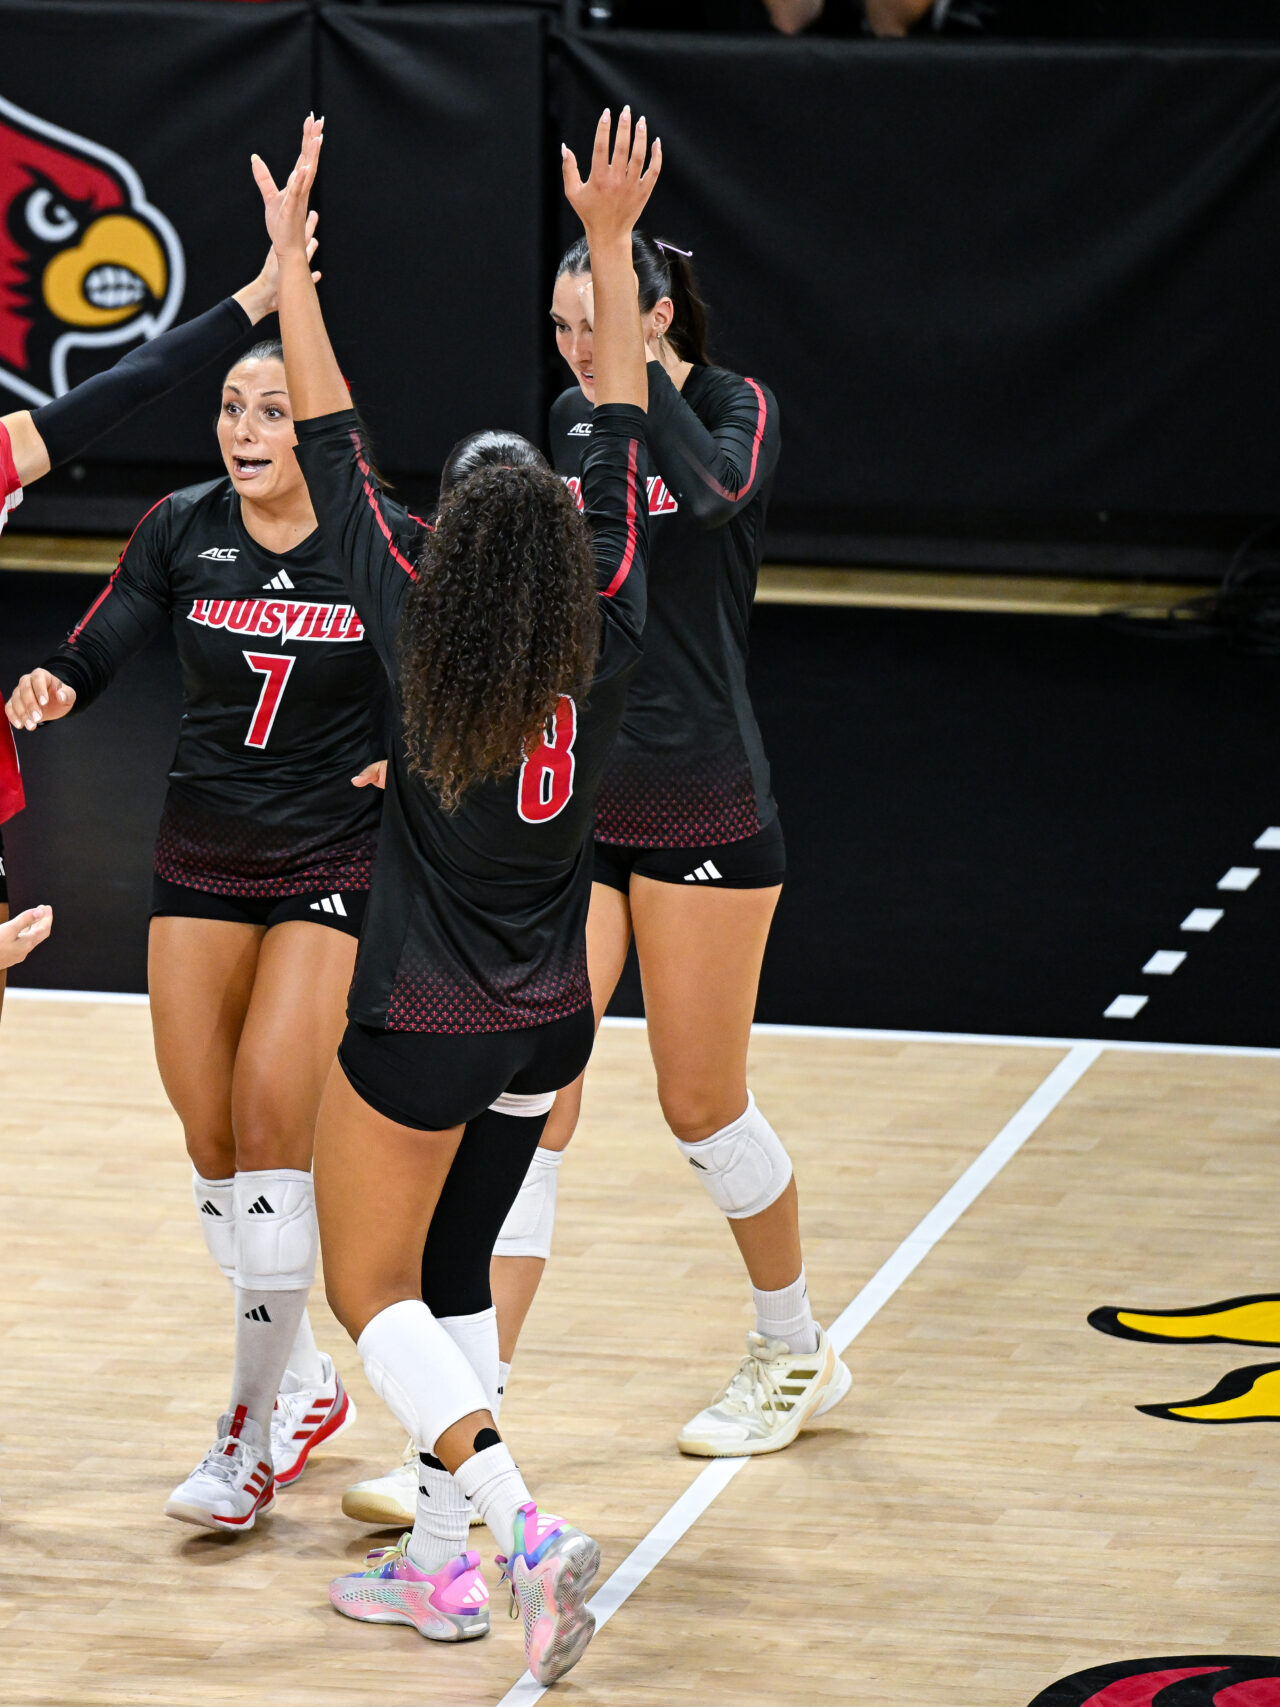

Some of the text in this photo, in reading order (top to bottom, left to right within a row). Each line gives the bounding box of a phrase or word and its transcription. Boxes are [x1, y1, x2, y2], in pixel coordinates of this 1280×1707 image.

[197, 547, 241, 562] ACC
[242, 650, 297, 750] 7
[517, 692, 577, 824] 8
